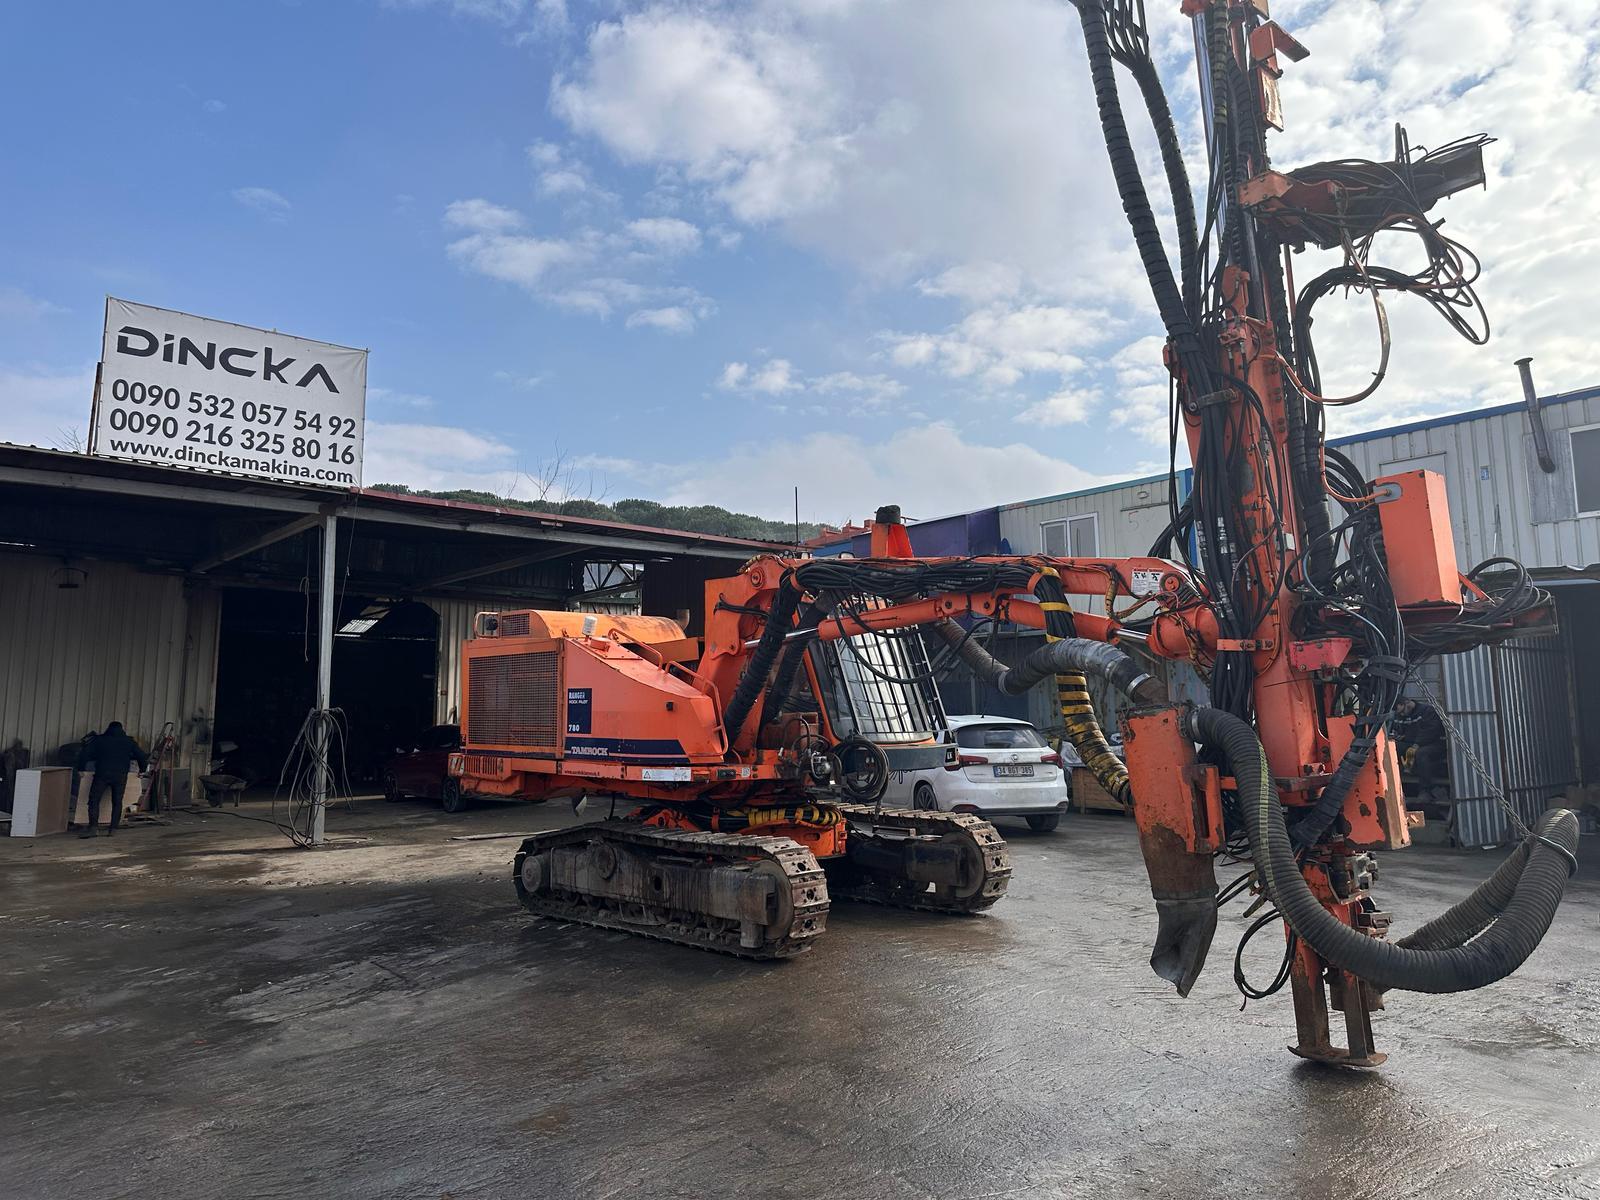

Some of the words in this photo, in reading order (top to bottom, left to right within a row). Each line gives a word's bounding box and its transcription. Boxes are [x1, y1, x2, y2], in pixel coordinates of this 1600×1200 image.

[112, 378, 181, 410] 0090
[187, 391, 235, 419] 532
[241, 401, 288, 427] 057
[293, 409, 322, 435] 54
[328, 415, 356, 439] 92
[109, 408, 179, 439] 0090
[185, 420, 233, 447] 216
[240, 428, 285, 455] 325
[291, 436, 321, 460] 80
[327, 442, 355, 465] 16
[110, 439, 353, 484] www.dinckamakina.com
[571, 746, 608, 756] TAMROCK
